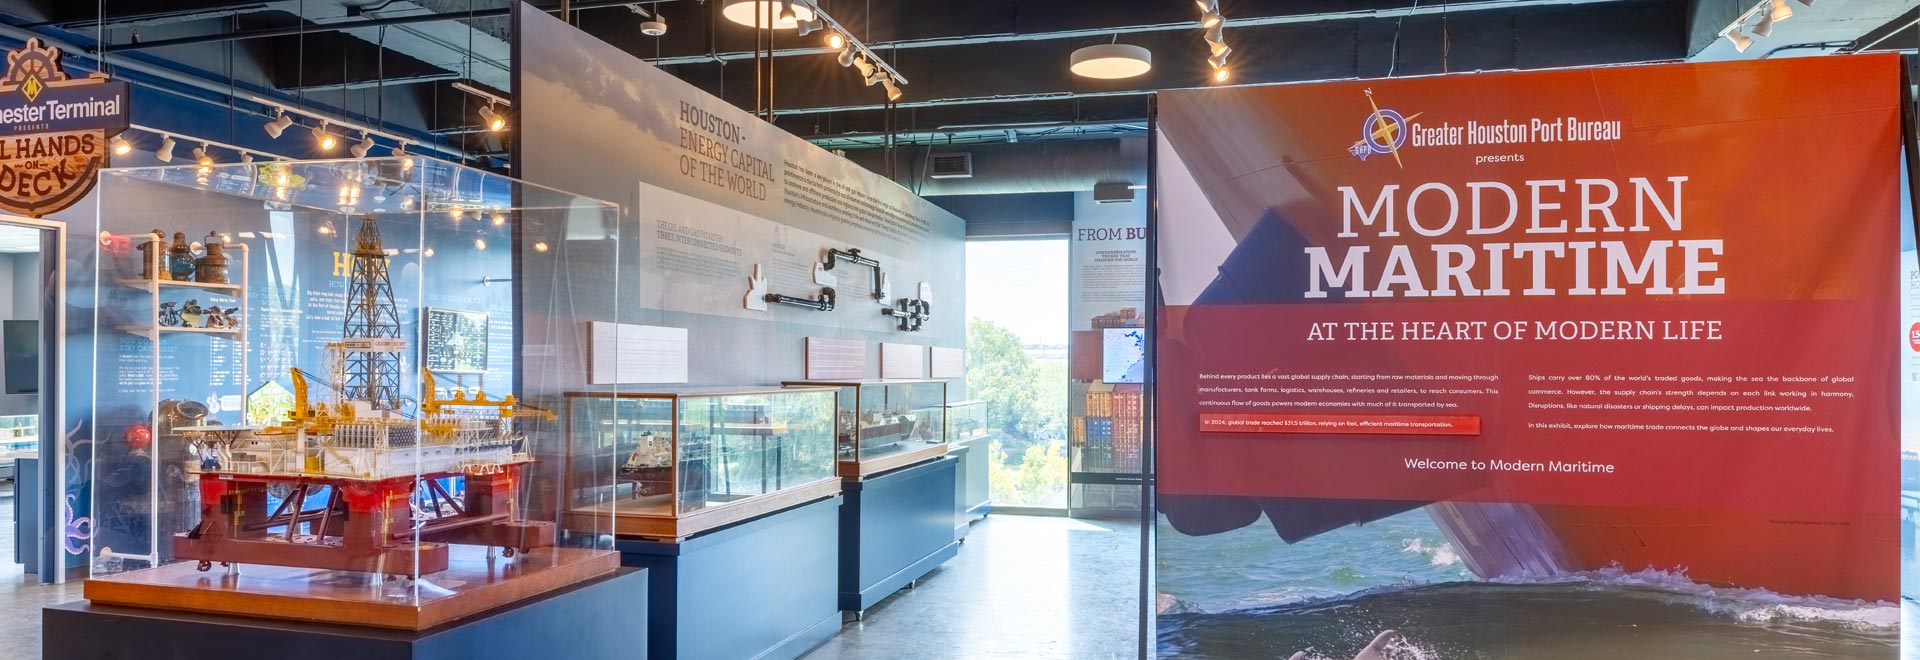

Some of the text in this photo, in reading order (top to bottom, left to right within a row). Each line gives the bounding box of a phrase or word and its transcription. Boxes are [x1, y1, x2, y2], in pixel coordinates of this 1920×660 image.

[46, 95, 120, 120] Terminal
[14, 123, 49, 131] PRESENTS
[680, 100, 740, 144] HOUSTON
[1412, 117, 1621, 147] Greater Houston Port Bureau
[15, 133, 95, 159] HANDS
[680, 127, 775, 182] ENERGY CAPITAL
[1475, 153, 1525, 165] presents
[24, 160, 39, 170] ON
[0, 158, 77, 197] DECK
[680, 154, 767, 201] OF THE WORLD
[1337, 175, 1689, 238] MODERN
[1077, 228, 1122, 241] FROM
[1304, 239, 1725, 298] MARITIME
[1307, 320, 1722, 341] AT THE HEART OF MODERN LIFE
[1290, 374, 1310, 382] global
[1311, 374, 1330, 382] supply
[1351, 374, 1375, 382] starting
[1448, 375, 1472, 383] moving
[1473, 375, 1498, 383] through
[1528, 374, 1545, 382] Ships
[1706, 375, 1732, 383] making
[1831, 376, 1853, 384] global
[1614, 389, 1635, 397] supply
[1665, 390, 1693, 398] strength
[1697, 390, 1726, 398] depends
[1779, 390, 1806, 398] working
[1398, 402, 1435, 410] transported
[1642, 403, 1670, 411] shipping
[1710, 404, 1735, 412] impact
[1735, 404, 1773, 412] production
[1573, 423, 1598, 431] explore
[1709, 425, 1728, 433] globe
[1745, 425, 1769, 433] shapes
[1783, 426, 1815, 434] everyday
[1404, 458, 1614, 472] Welcome to Modern Maritime
